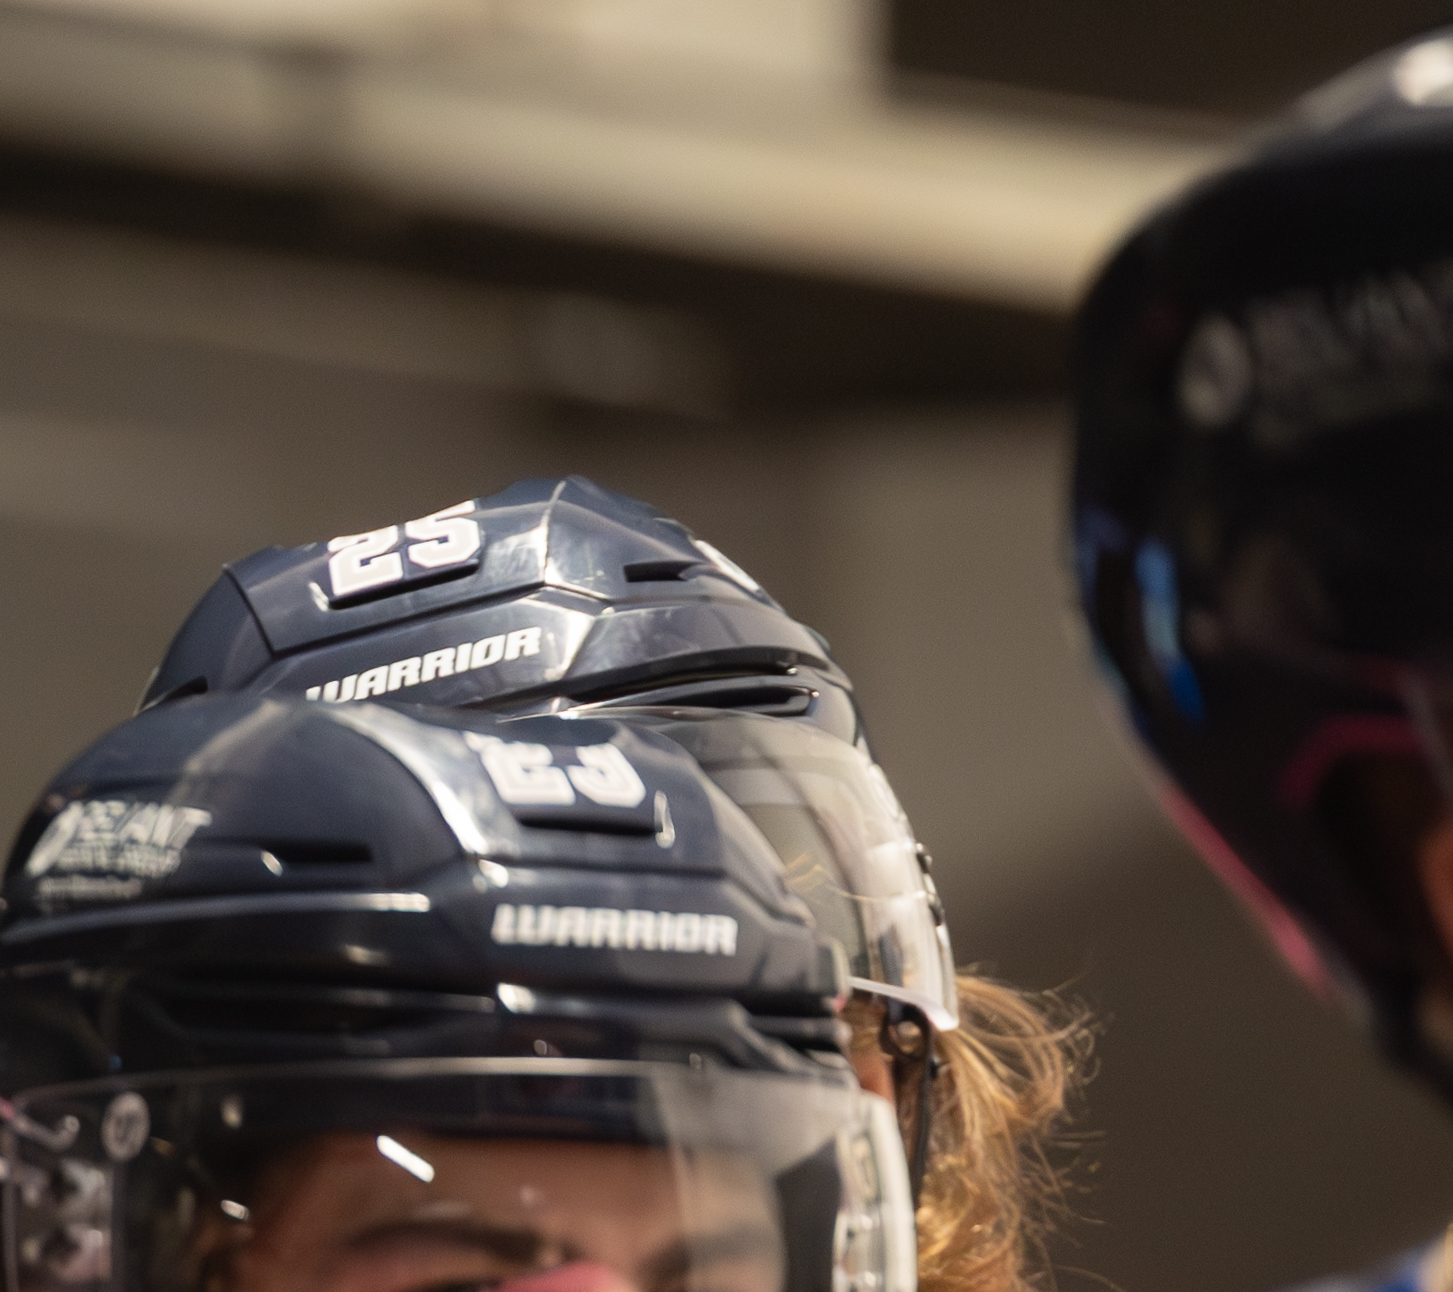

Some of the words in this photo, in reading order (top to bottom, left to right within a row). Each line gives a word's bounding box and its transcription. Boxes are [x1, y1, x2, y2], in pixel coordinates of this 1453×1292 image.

[327, 500, 482, 598] 25
[305, 626, 542, 703] WARRIOR
[492, 902, 739, 956] WARRIOR
